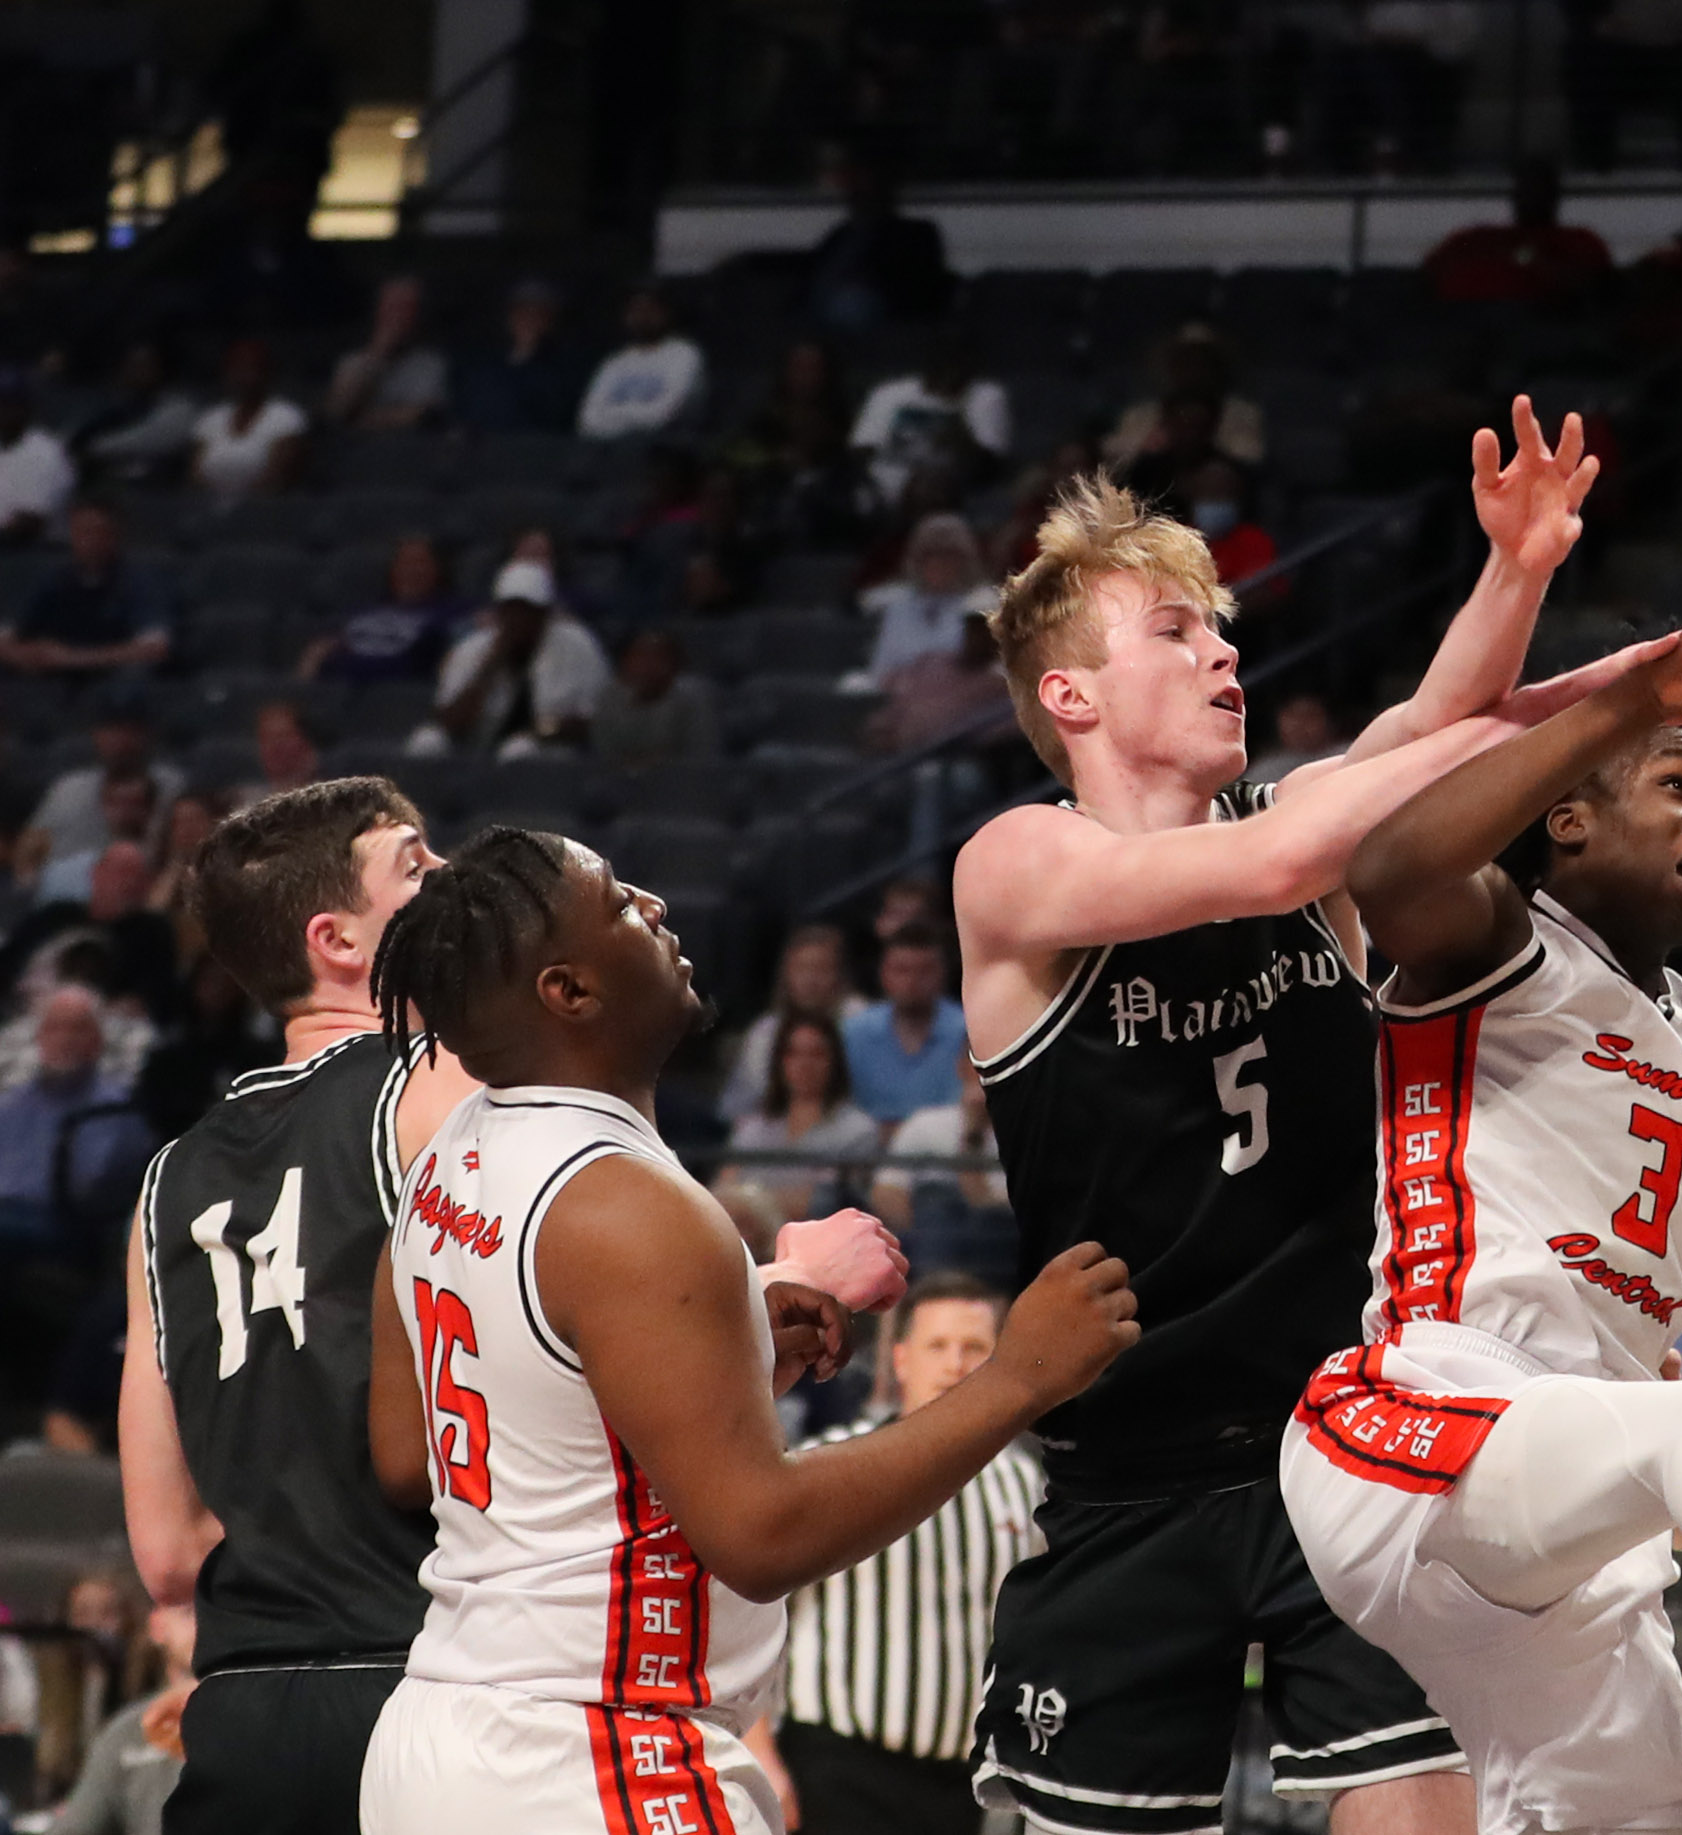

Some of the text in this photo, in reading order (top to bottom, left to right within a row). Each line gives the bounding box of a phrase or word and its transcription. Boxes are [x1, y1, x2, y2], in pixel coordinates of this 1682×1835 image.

[1108, 950, 1342, 1048] Plainview
[1213, 1034, 1270, 1176] 5
[1404, 1081, 1442, 1117] SC
[1405, 1129, 1440, 1166] SC
[1403, 1175, 1443, 1211] SC
[190, 1167, 306, 1381] 14
[413, 1275, 492, 1514] 15
[643, 1553, 685, 1580] SC
[642, 1597, 682, 1635] SC
[636, 1653, 680, 1689] SC
[630, 1734, 677, 1777] SC
[642, 1793, 698, 1835] SC
